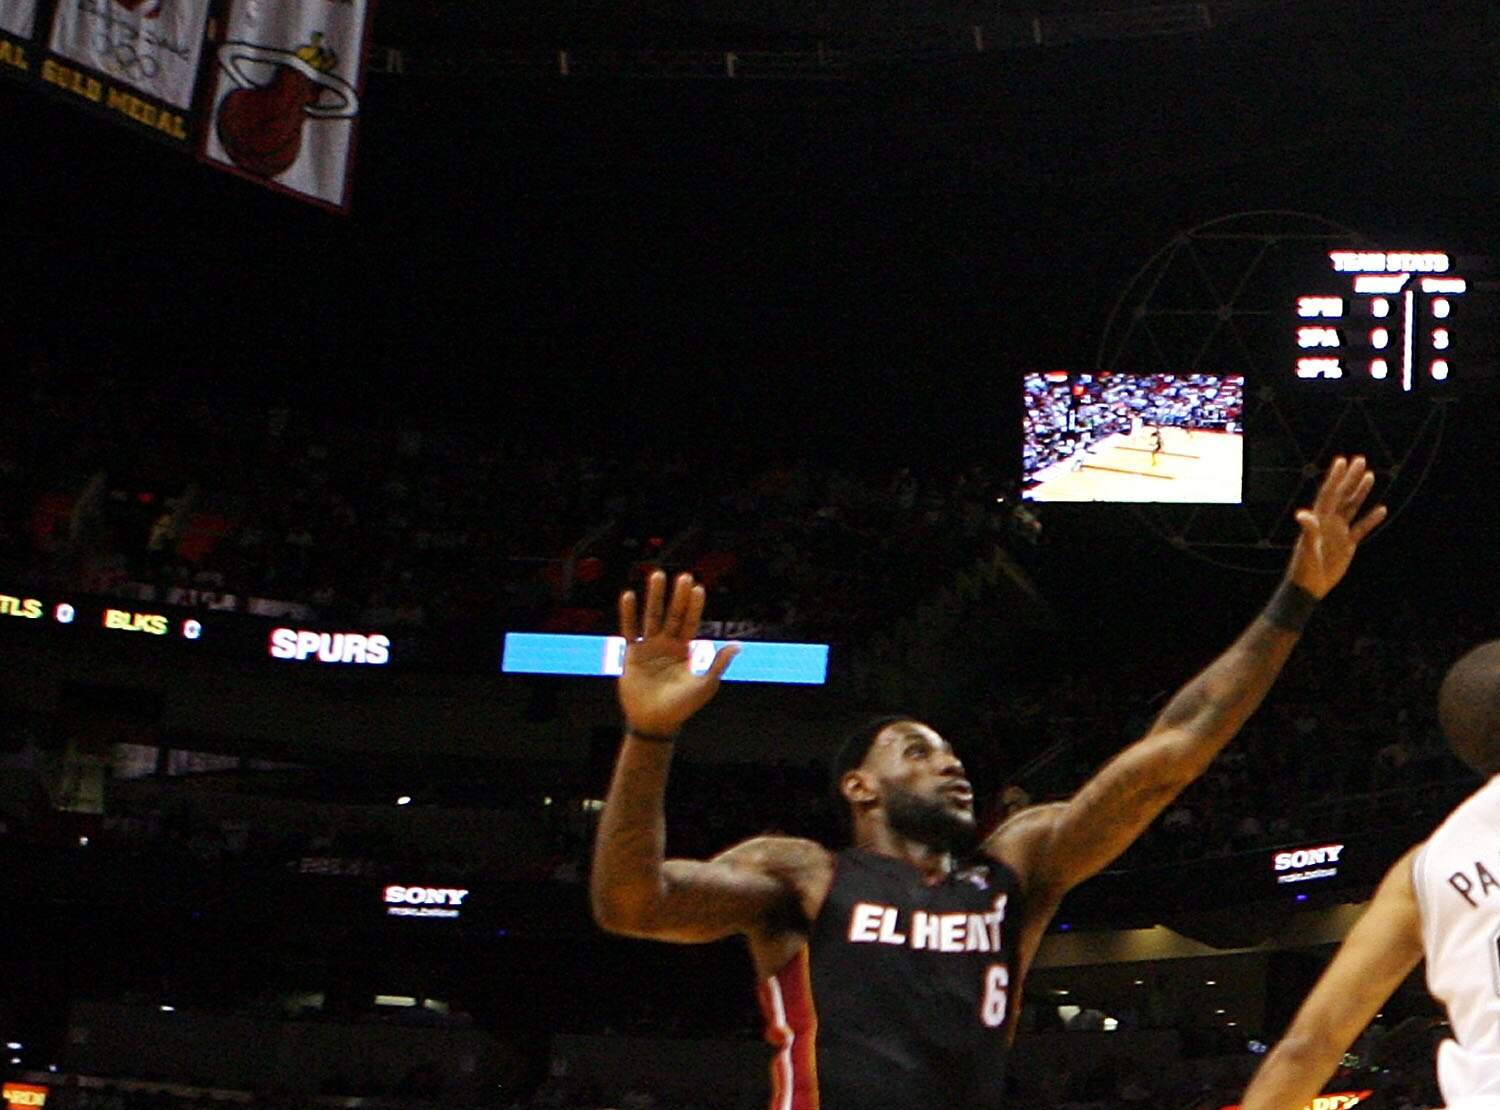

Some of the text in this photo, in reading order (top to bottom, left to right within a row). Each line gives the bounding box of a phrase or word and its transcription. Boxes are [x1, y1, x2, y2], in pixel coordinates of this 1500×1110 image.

[104, 608, 169, 636] BLKS
[270, 627, 391, 666] SPURS
[1271, 844, 1345, 871] SONY
[384, 884, 470, 905] SONY
[849, 893, 1009, 954] EL HEAT
[979, 962, 1010, 1028] 6
